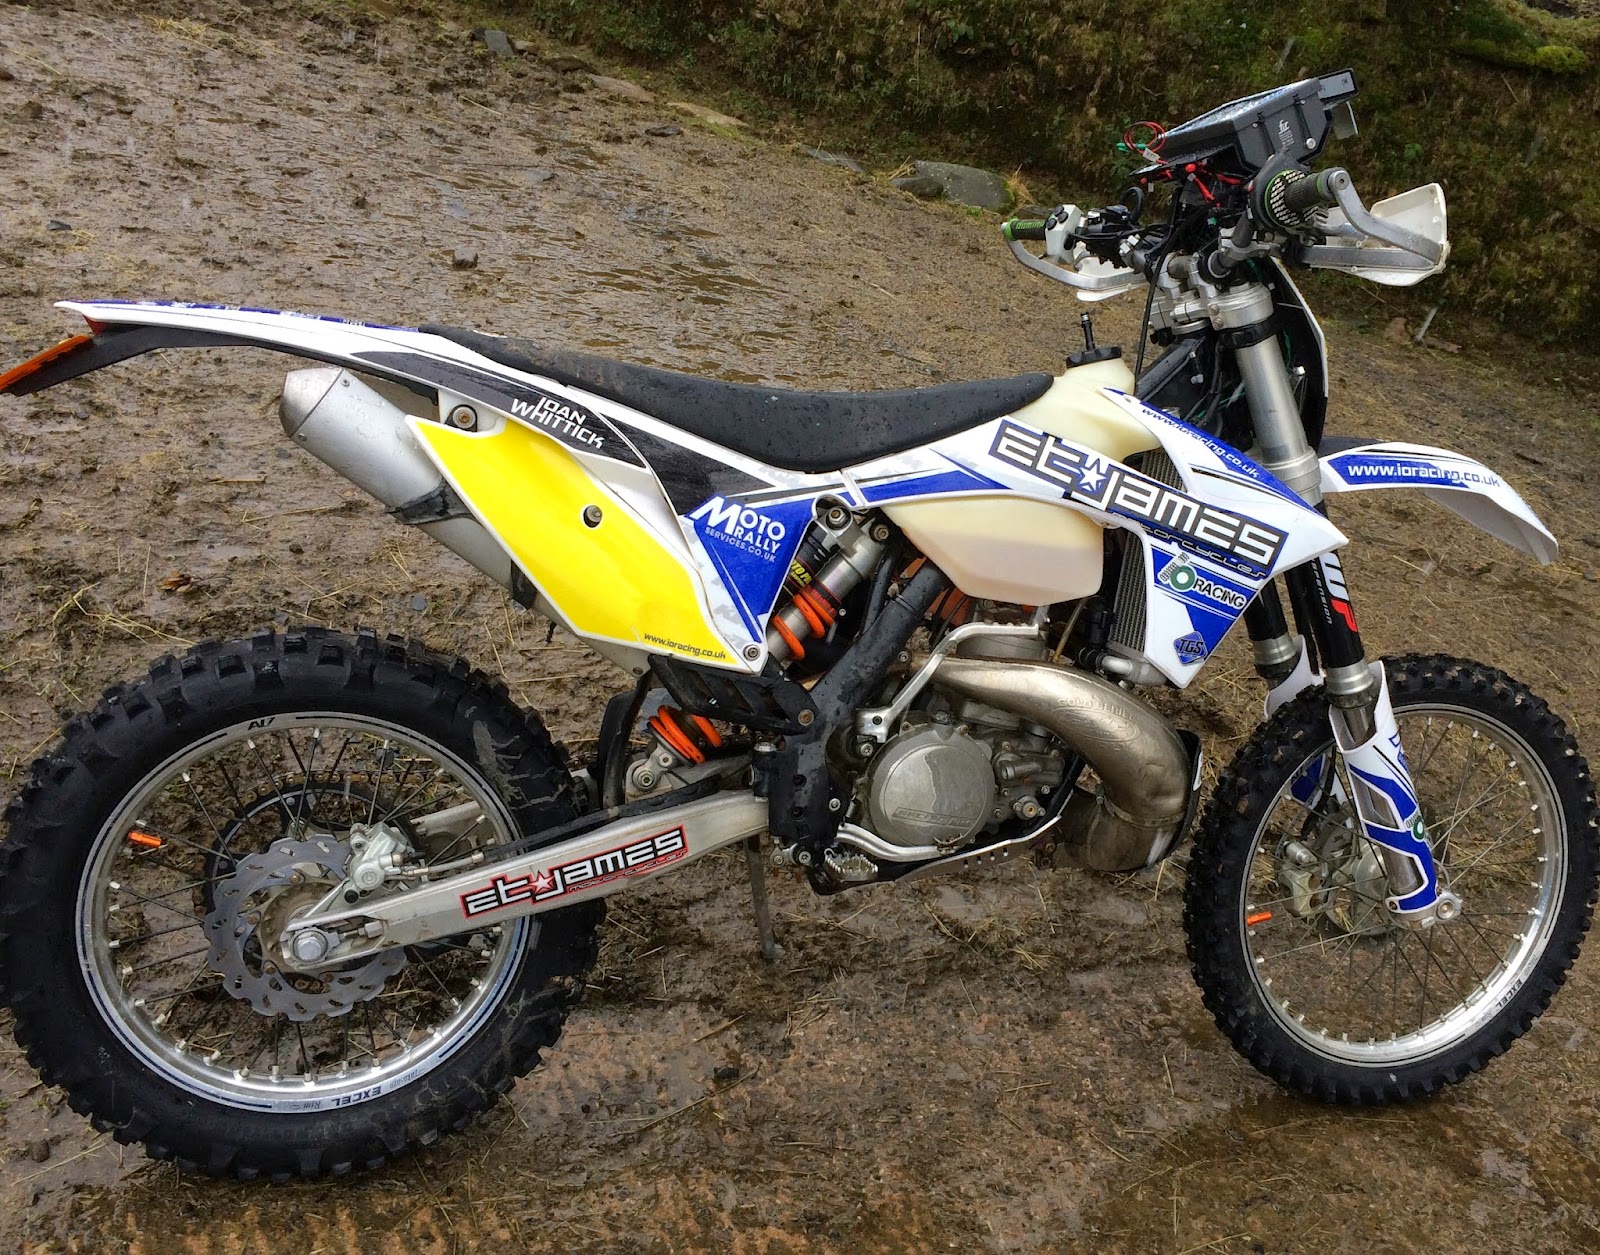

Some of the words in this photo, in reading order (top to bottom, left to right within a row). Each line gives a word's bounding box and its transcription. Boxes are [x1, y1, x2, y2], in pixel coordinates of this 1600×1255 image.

[511, 398, 606, 449] WHITTICK
[1141, 408, 1260, 478] www.ioracing.co.uk
[1347, 463, 1501, 488] www.ioracing.co.uk
[689, 495, 786, 541] MOTO
[704, 526, 777, 563] SERVICES.CO.UK
[733, 526, 781, 554] RALLY
[644, 632, 726, 659] www.ioracing.co.uk
[1180, 639, 1204, 654] TGS
[1495, 978, 1523, 1009] EXCEL
[331, 1085, 382, 1107] EXCEL
